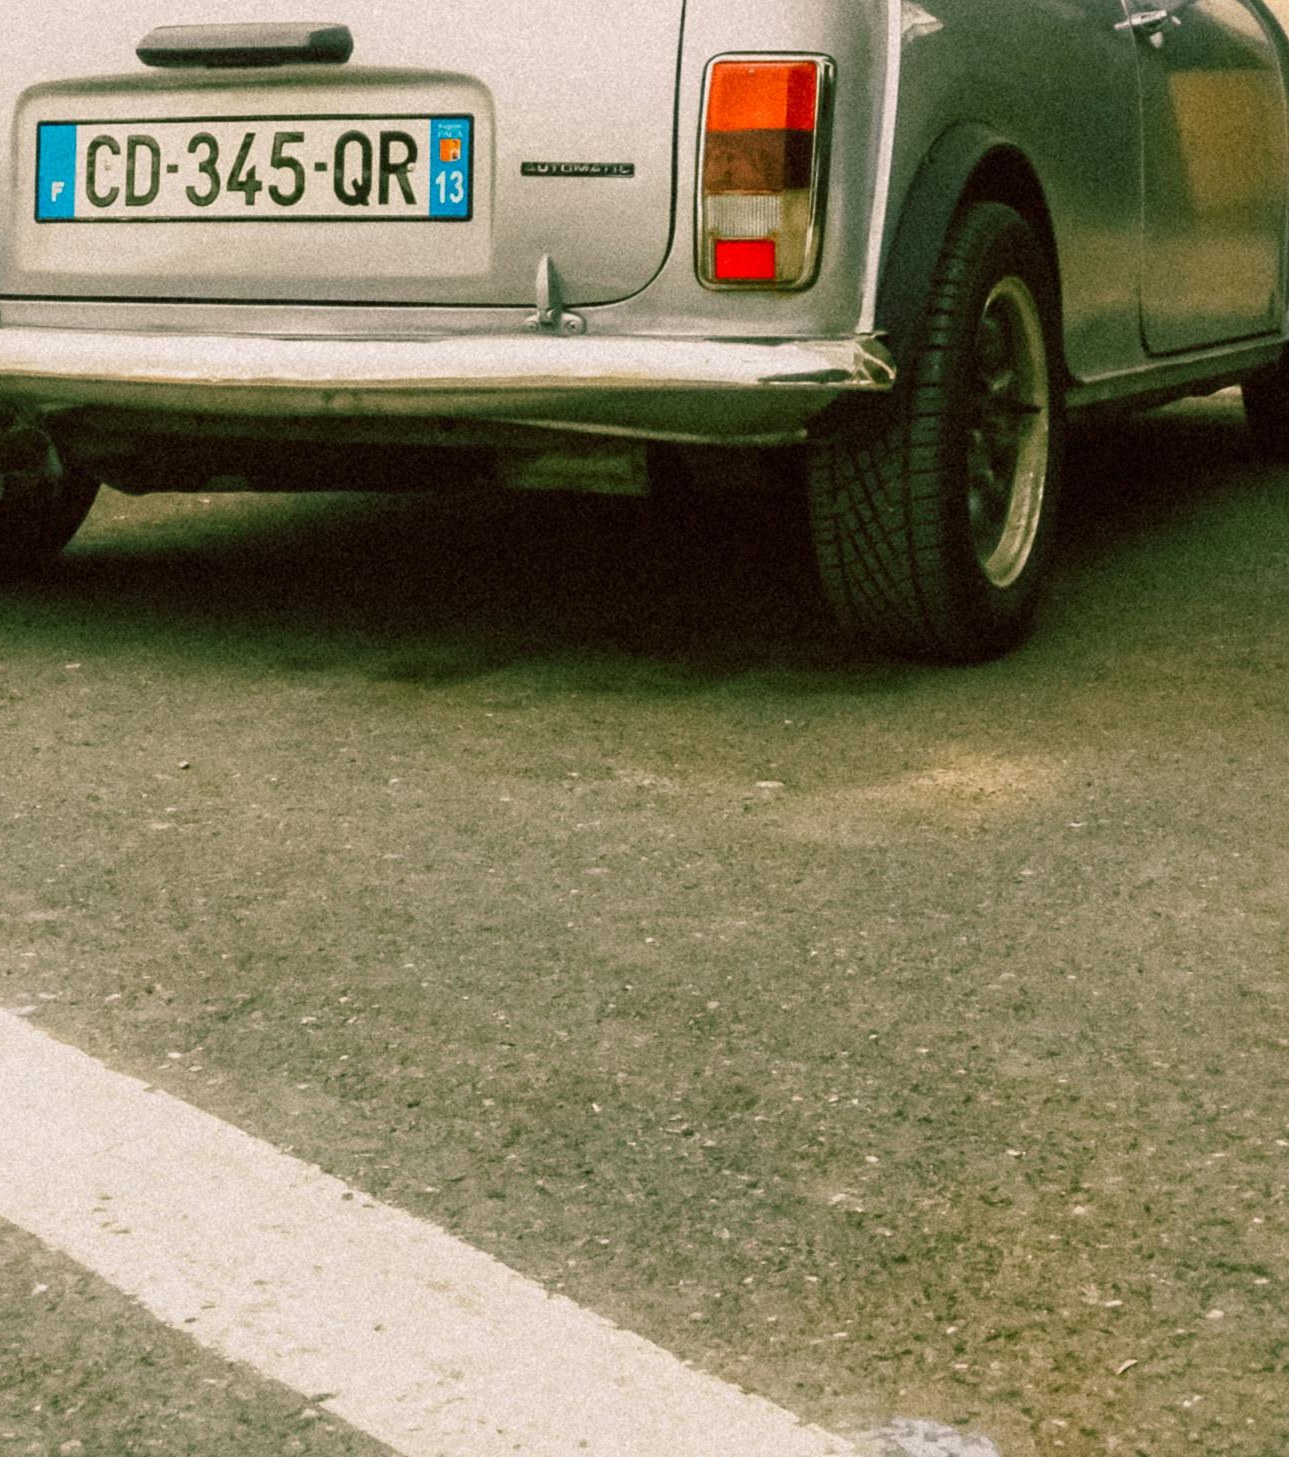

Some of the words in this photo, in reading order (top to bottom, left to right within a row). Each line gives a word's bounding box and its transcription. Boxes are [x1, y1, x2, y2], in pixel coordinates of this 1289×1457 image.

[84, 129, 419, 209] CD-345-QR
[50, 181, 65, 203] F
[434, 170, 465, 205] 13
